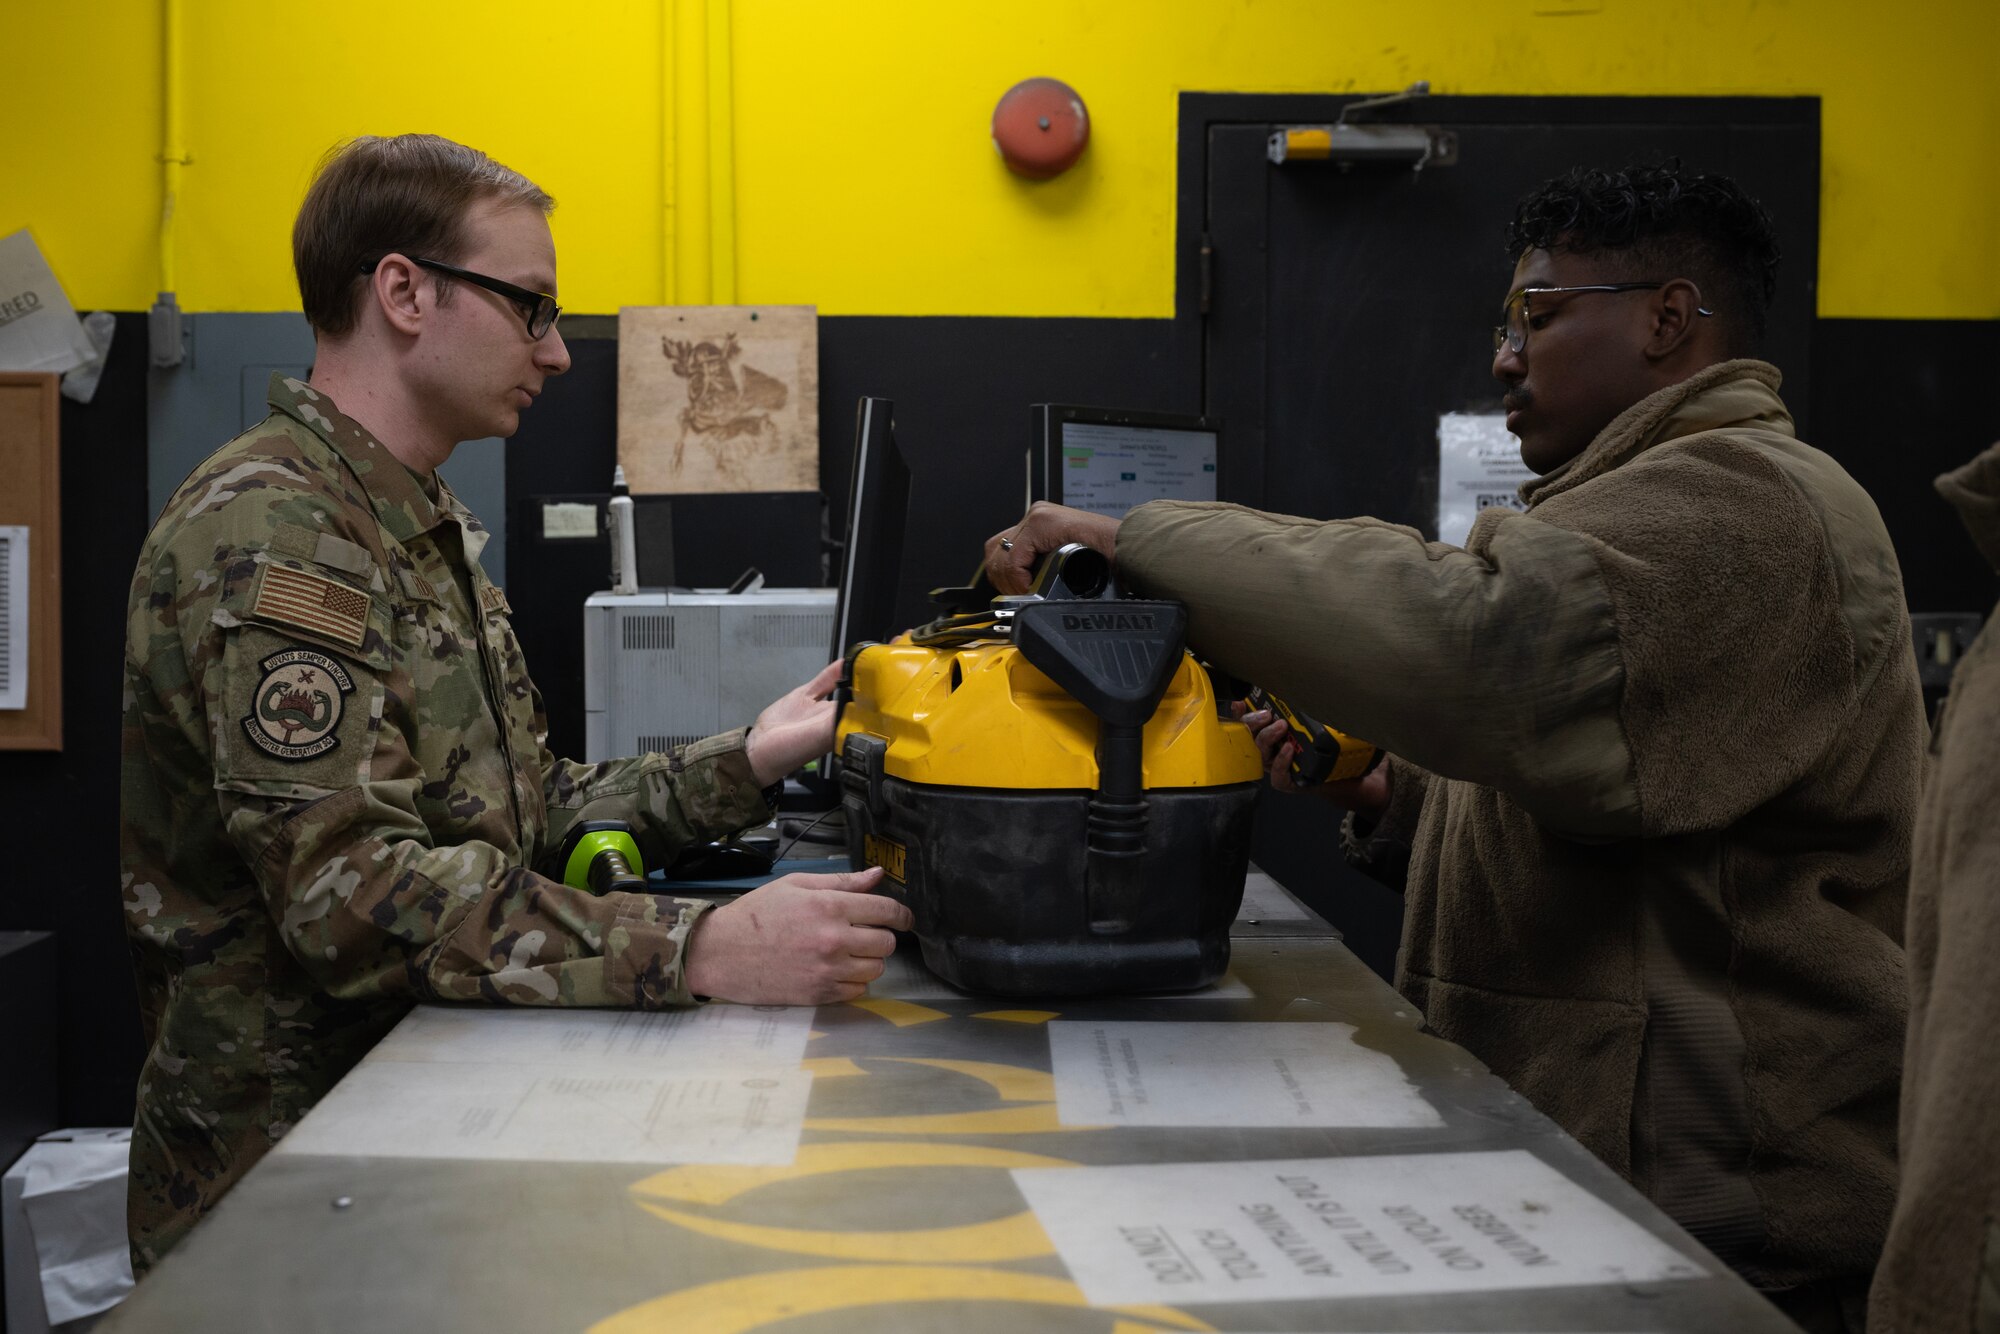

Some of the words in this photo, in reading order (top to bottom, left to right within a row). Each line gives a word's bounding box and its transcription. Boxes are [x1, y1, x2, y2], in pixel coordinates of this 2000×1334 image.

[268, 652, 295, 669] JUVATS
[297, 652, 327, 666] SEMPER
[326, 661, 350, 688] VINCERE
[256, 733, 280, 752] FIGHTER
[280, 743, 323, 757] GENERATION
[1275, 1175, 1331, 1200] PUT
[1118, 1225, 1171, 1258] NOT
[1239, 1203, 1343, 1277] ANYTHING
[1381, 1204, 1451, 1244] YOUR
[1451, 1204, 1562, 1266] NUMBER
[1193, 1228, 1267, 1283] TOUCH
[1341, 1230, 1413, 1275] UNTIL
[1428, 1246, 1485, 1271] ON
[1146, 1257, 1196, 1285] DO
